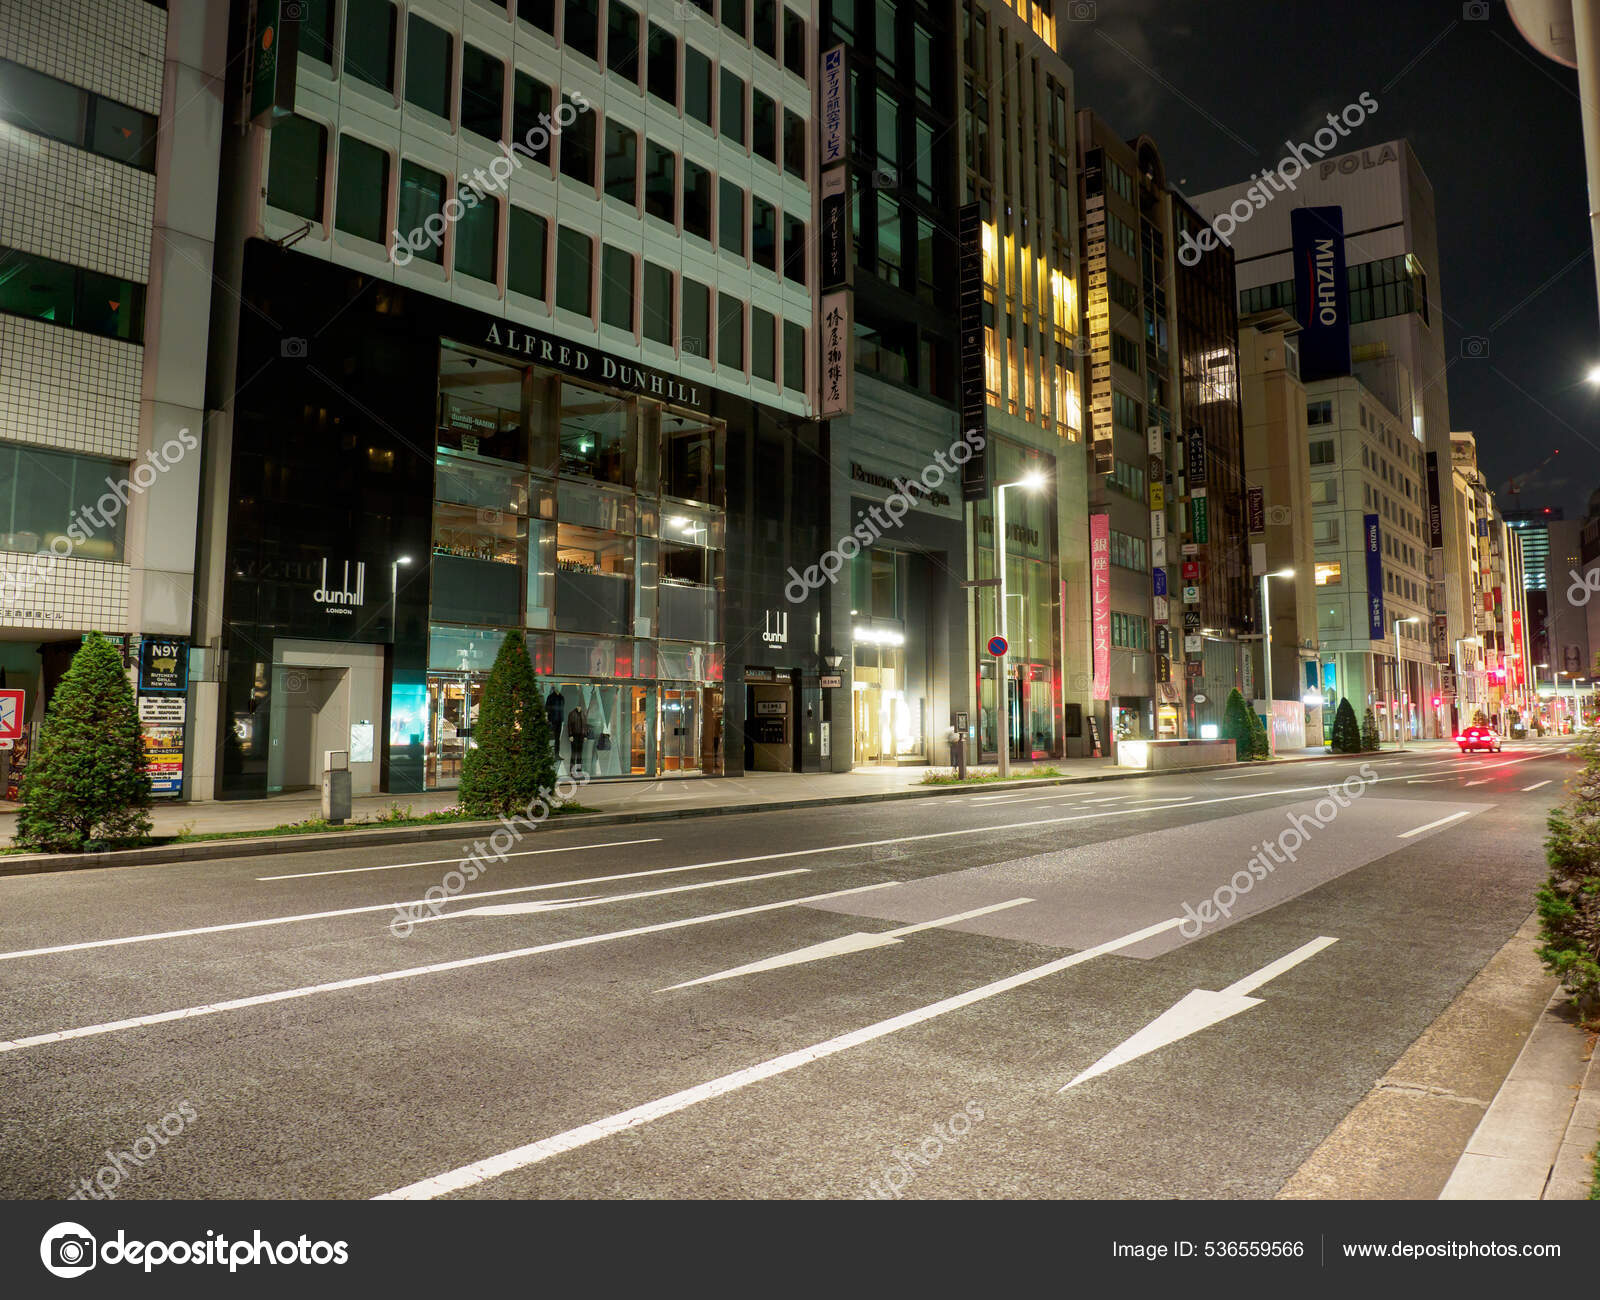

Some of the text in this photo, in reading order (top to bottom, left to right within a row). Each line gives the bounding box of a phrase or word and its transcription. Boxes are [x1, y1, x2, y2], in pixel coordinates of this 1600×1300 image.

[826, 71, 840, 160] テック航空サービス
[1319, 145, 1398, 181] POLA
[1315, 239, 1337, 326] MIZUHO
[485, 322, 700, 406] ALFRED DUNHILL
[313, 557, 365, 606] dunhill
[325, 607, 352, 615] LONDON
[1094, 538, 1109, 651] 銀座トレシャス
[152, 645, 179, 657] N9Y
